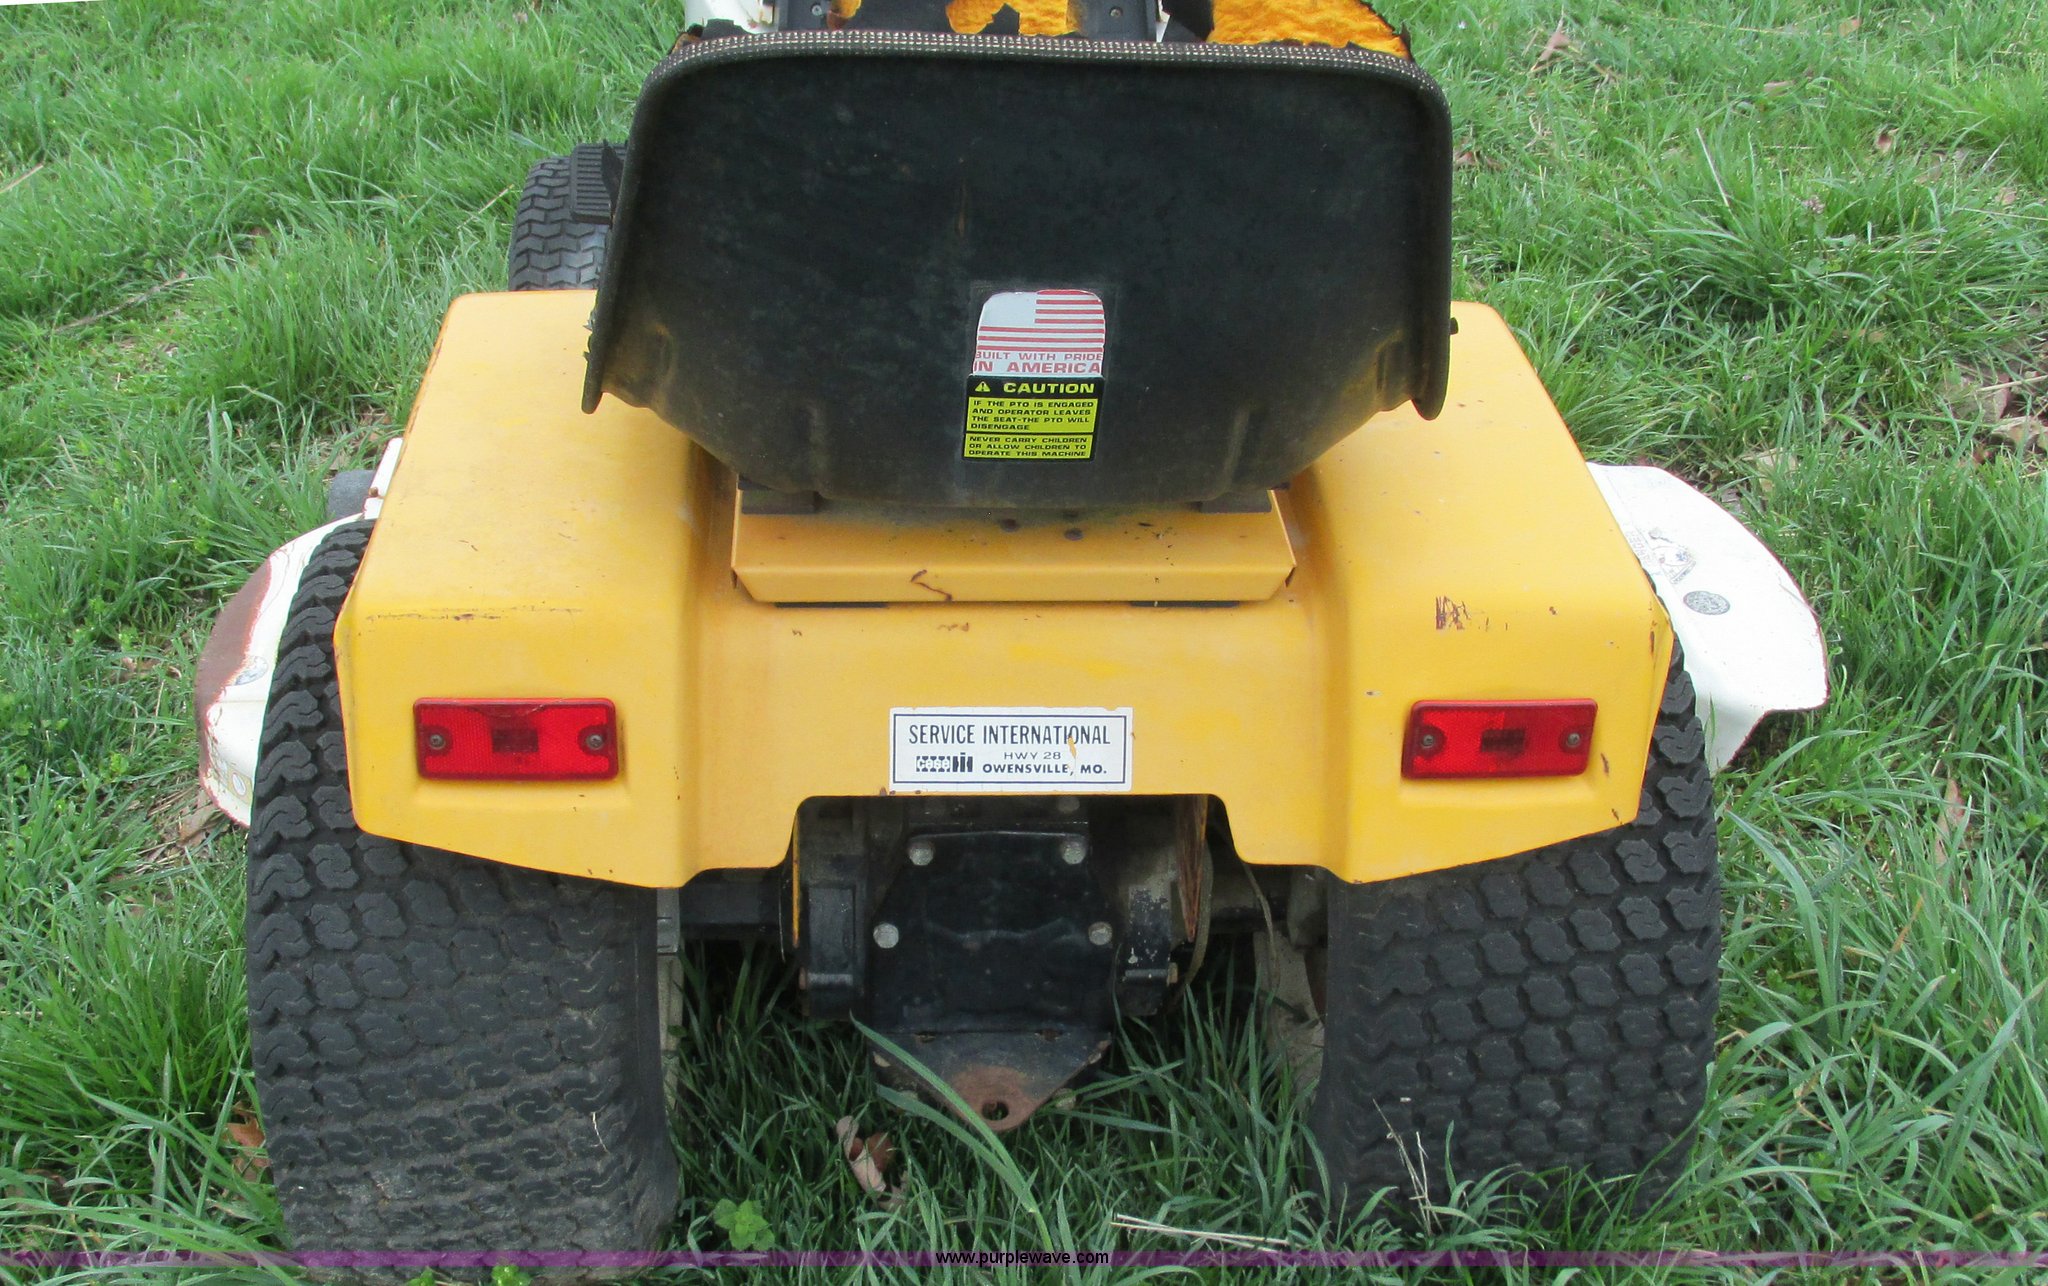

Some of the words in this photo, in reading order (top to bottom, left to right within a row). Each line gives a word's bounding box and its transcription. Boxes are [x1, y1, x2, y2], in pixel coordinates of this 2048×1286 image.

[1019, 353, 1056, 361] WITH
[974, 361, 992, 372] IN
[1007, 362, 1100, 373] AMERICA
[1003, 383, 1094, 394] CAUTION
[909, 724, 975, 744] SERVICE
[983, 725, 1111, 745] INTERNATIONAL
[1004, 752, 1037, 760] HWY
[1043, 751, 1061, 760] 28
[983, 763, 1074, 776] OWENSVILLE,
[1080, 764, 1107, 774] MO.
